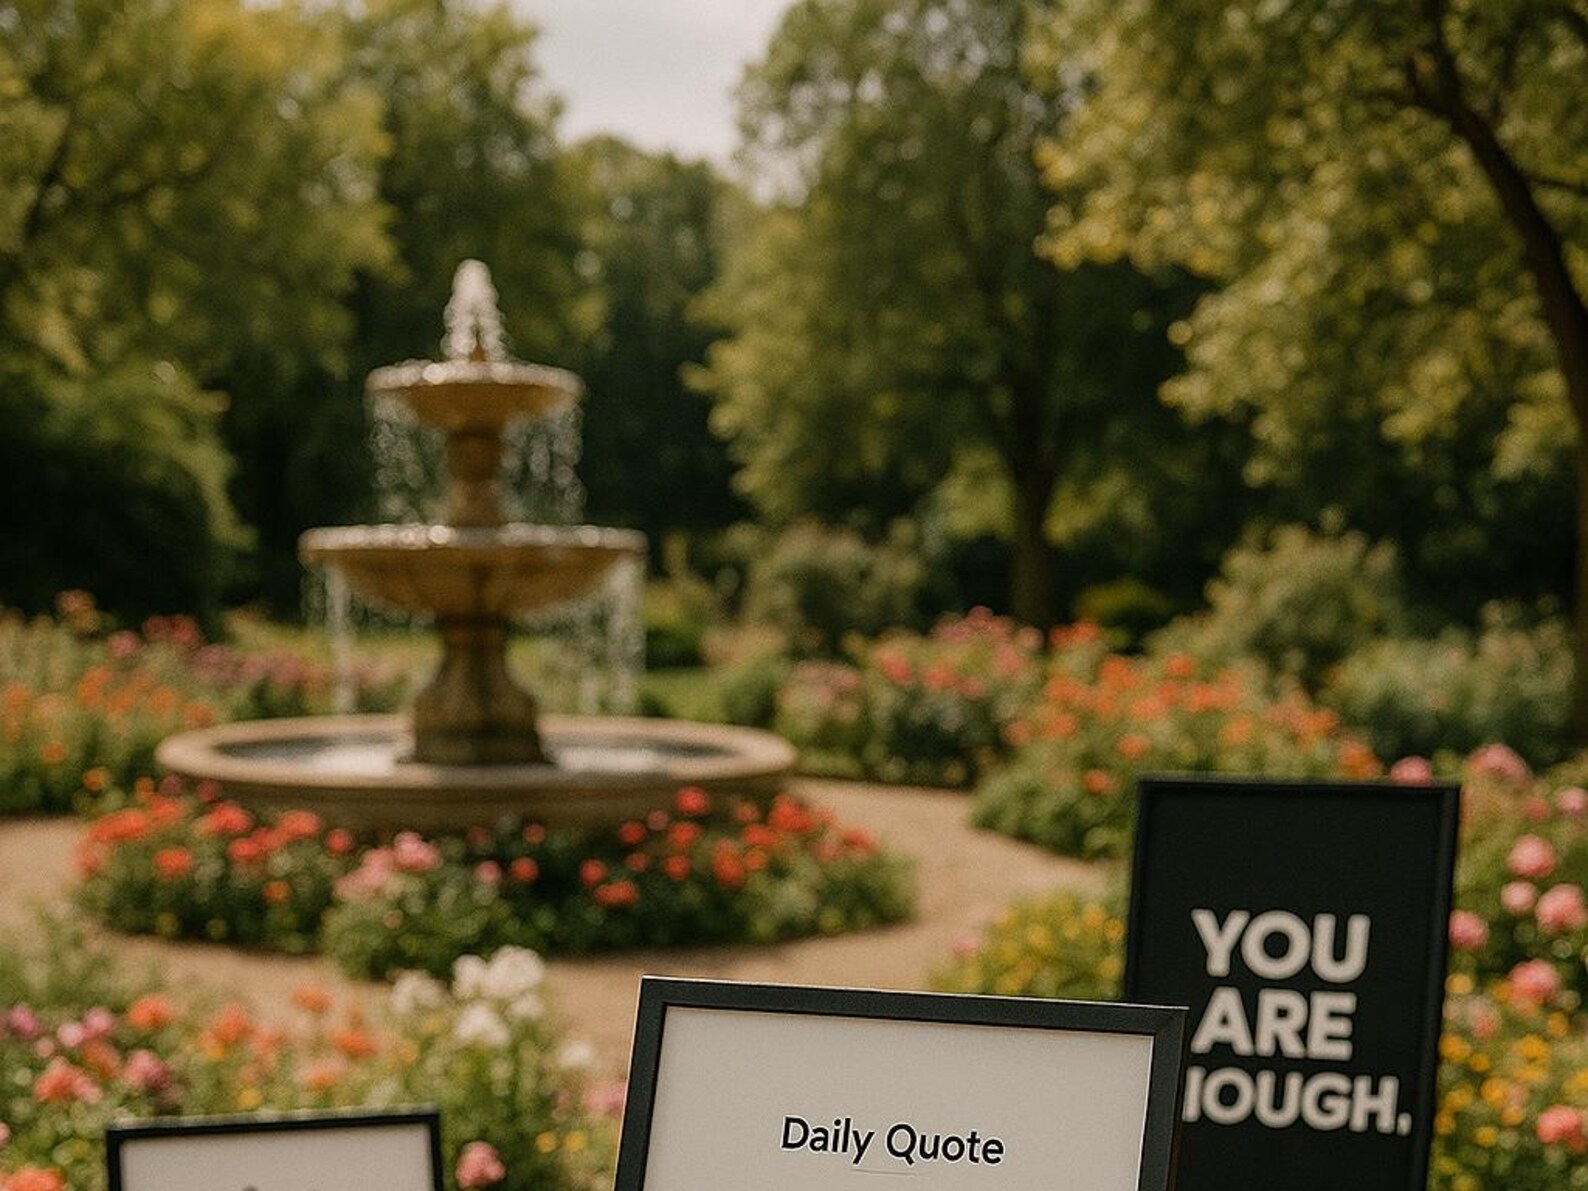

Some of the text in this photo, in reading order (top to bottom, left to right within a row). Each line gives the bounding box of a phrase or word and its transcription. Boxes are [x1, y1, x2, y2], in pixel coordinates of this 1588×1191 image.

[1191, 908, 1371, 983] YOU
[1190, 986, 1358, 1061] ARE
[781, 1116, 1004, 1166] Daily Quote
